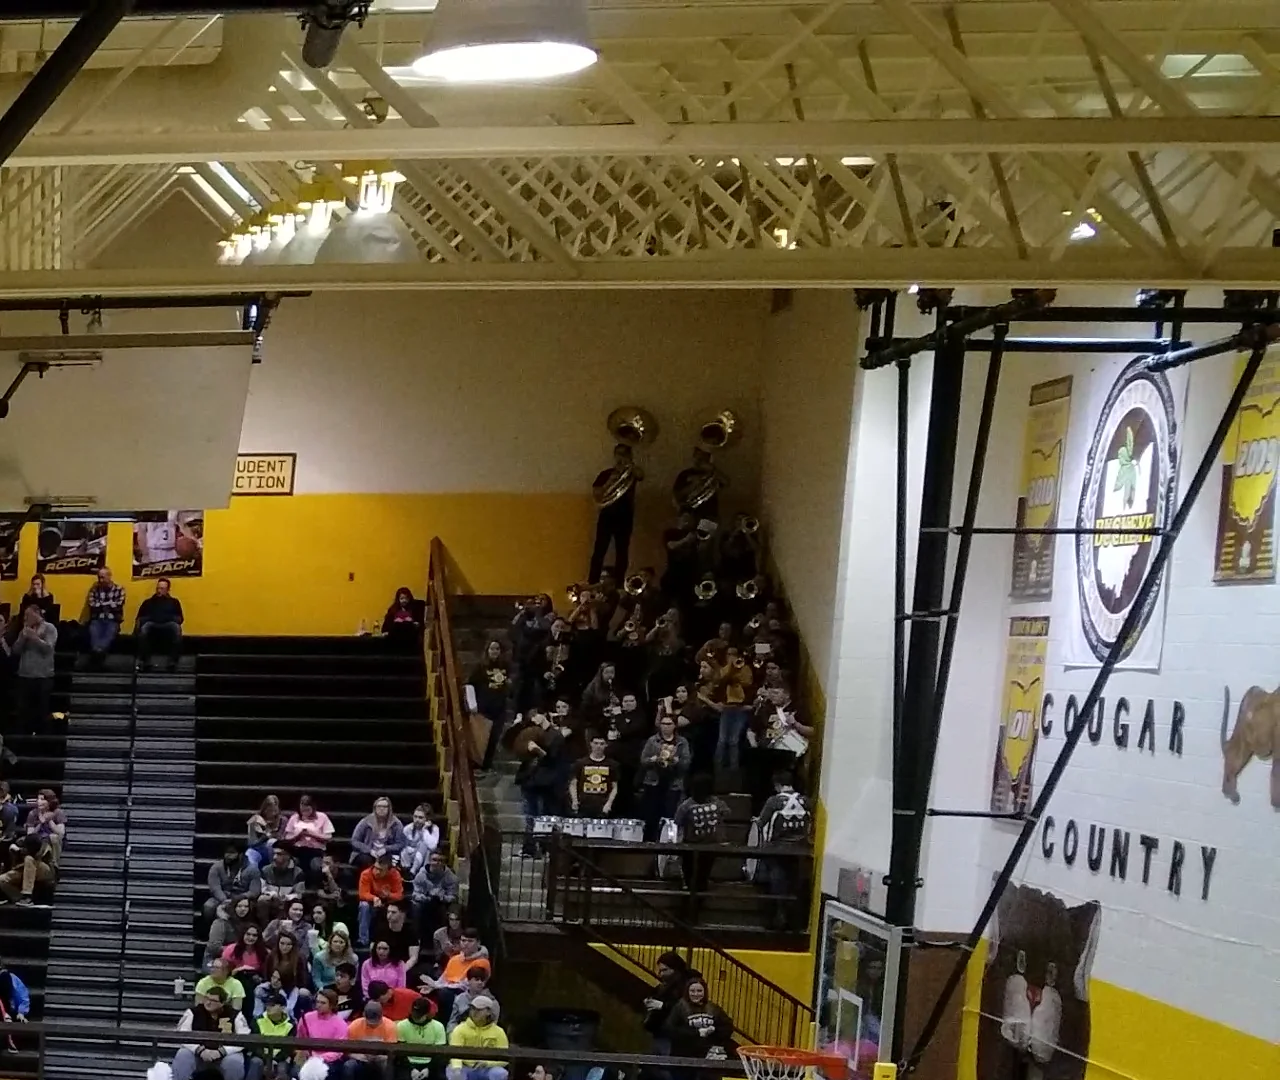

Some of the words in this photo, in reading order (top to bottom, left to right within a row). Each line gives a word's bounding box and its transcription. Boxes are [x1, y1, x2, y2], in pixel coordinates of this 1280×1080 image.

[1028, 475, 1056, 507] 2010
[162, 529, 168, 541] 3
[1094, 513, 1154, 549] BUCKEYE
[45, 557, 99, 571] ROACH
[141, 559, 195, 577] ROACH
[1041, 693, 1186, 758] COUGAR
[1041, 815, 1218, 900] COUNTRY
